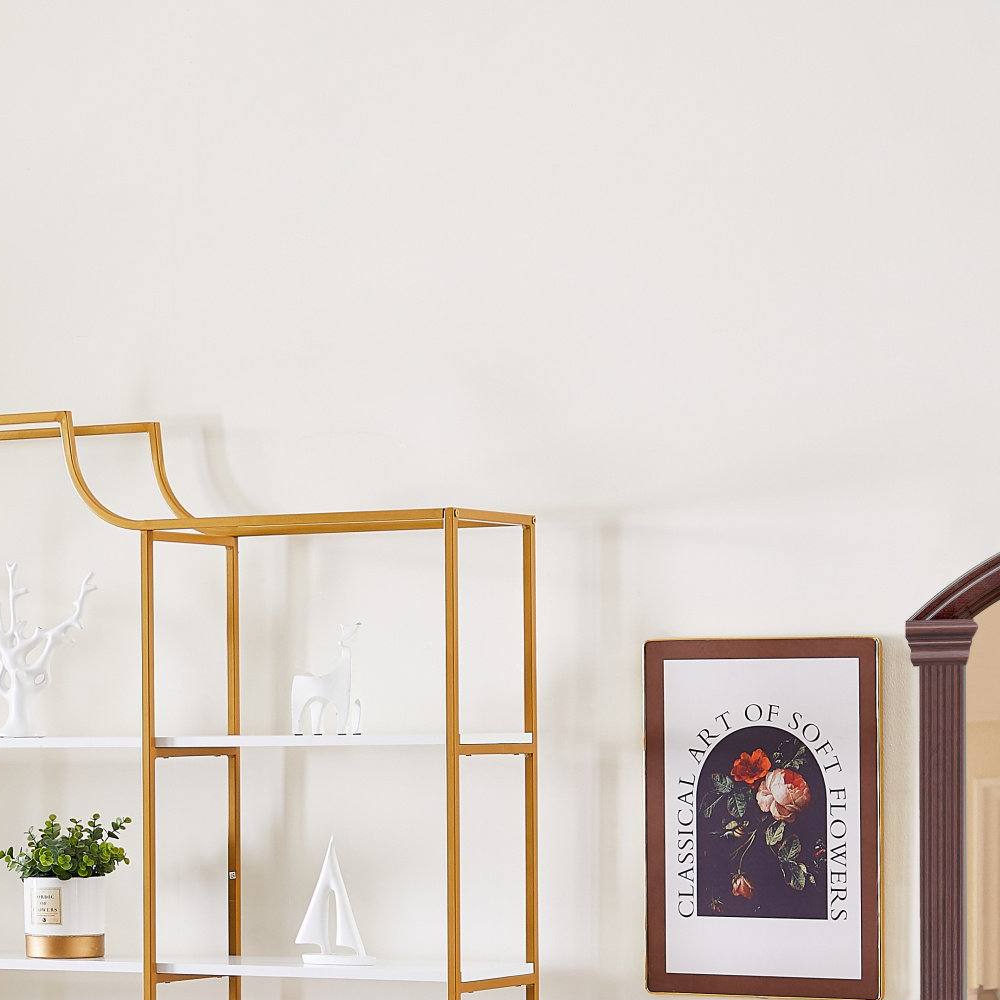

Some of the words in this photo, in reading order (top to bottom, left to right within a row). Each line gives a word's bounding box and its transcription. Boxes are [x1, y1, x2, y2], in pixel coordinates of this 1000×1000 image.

[677, 773, 697, 919] CLASSICAL
[687, 710, 733, 765] ART
[744, 703, 781, 723] OF
[787, 711, 843, 773] SOFT
[828, 786, 849, 922] FLOWERS
